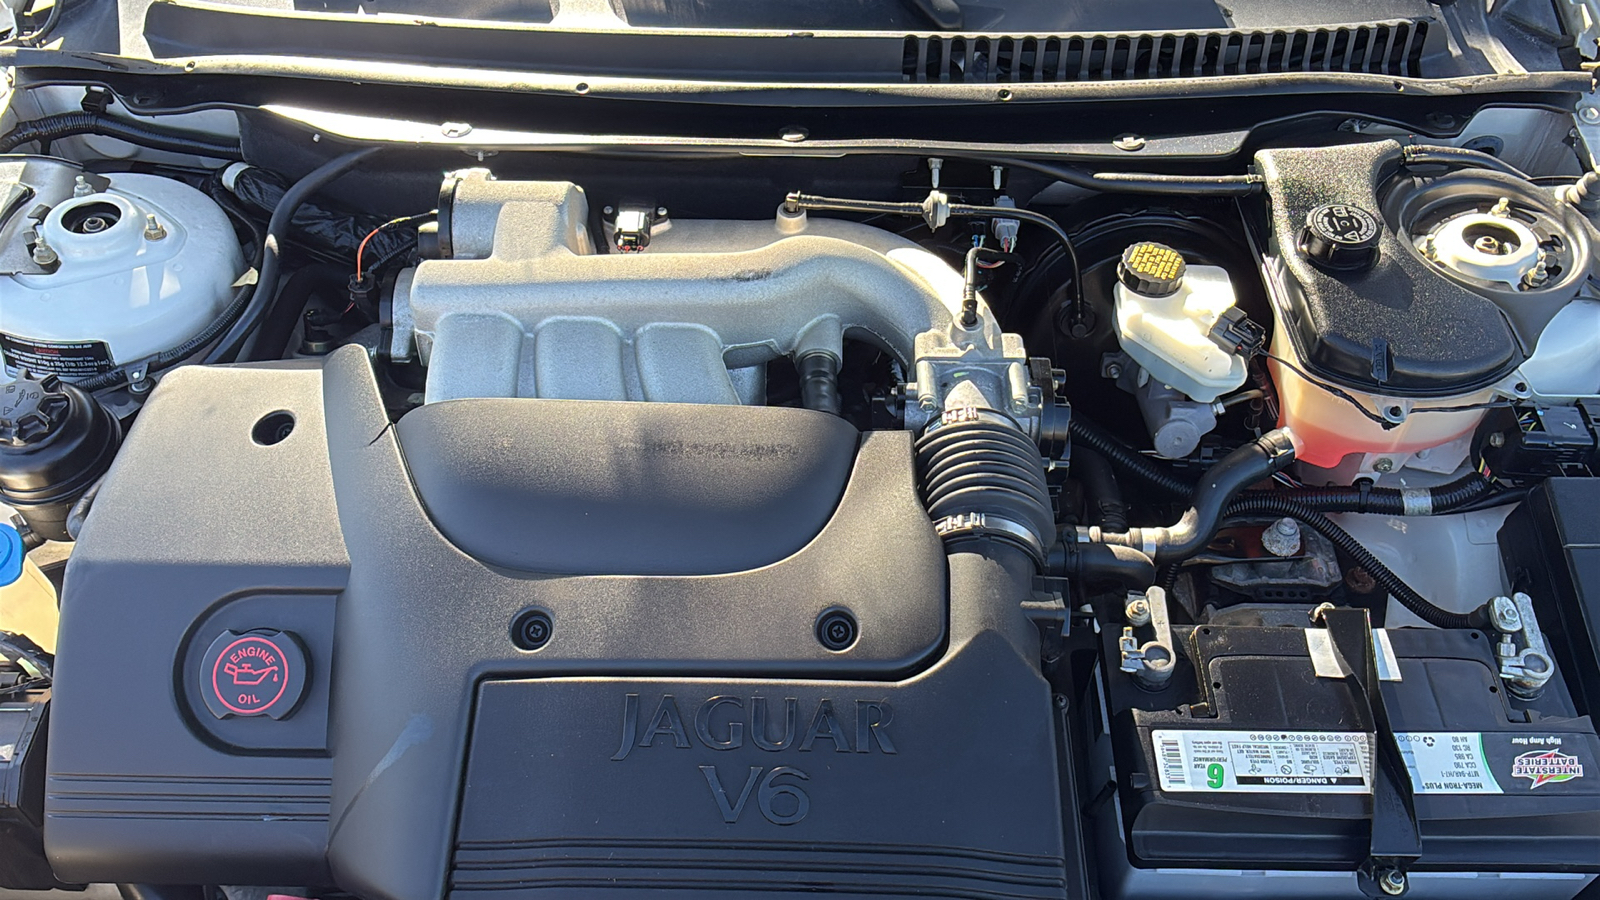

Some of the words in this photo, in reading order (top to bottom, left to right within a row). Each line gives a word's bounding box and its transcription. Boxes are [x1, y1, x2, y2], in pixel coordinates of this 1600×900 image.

[230, 646, 276, 666] ENGINE
[238, 694, 260, 704] OIL
[610, 694, 897, 761] JAGUAR
[1529, 736, 1544, 744] Amp
[1546, 736, 1562, 744] High
[1207, 763, 1224, 789] 6
[698, 766, 810, 826] V6
